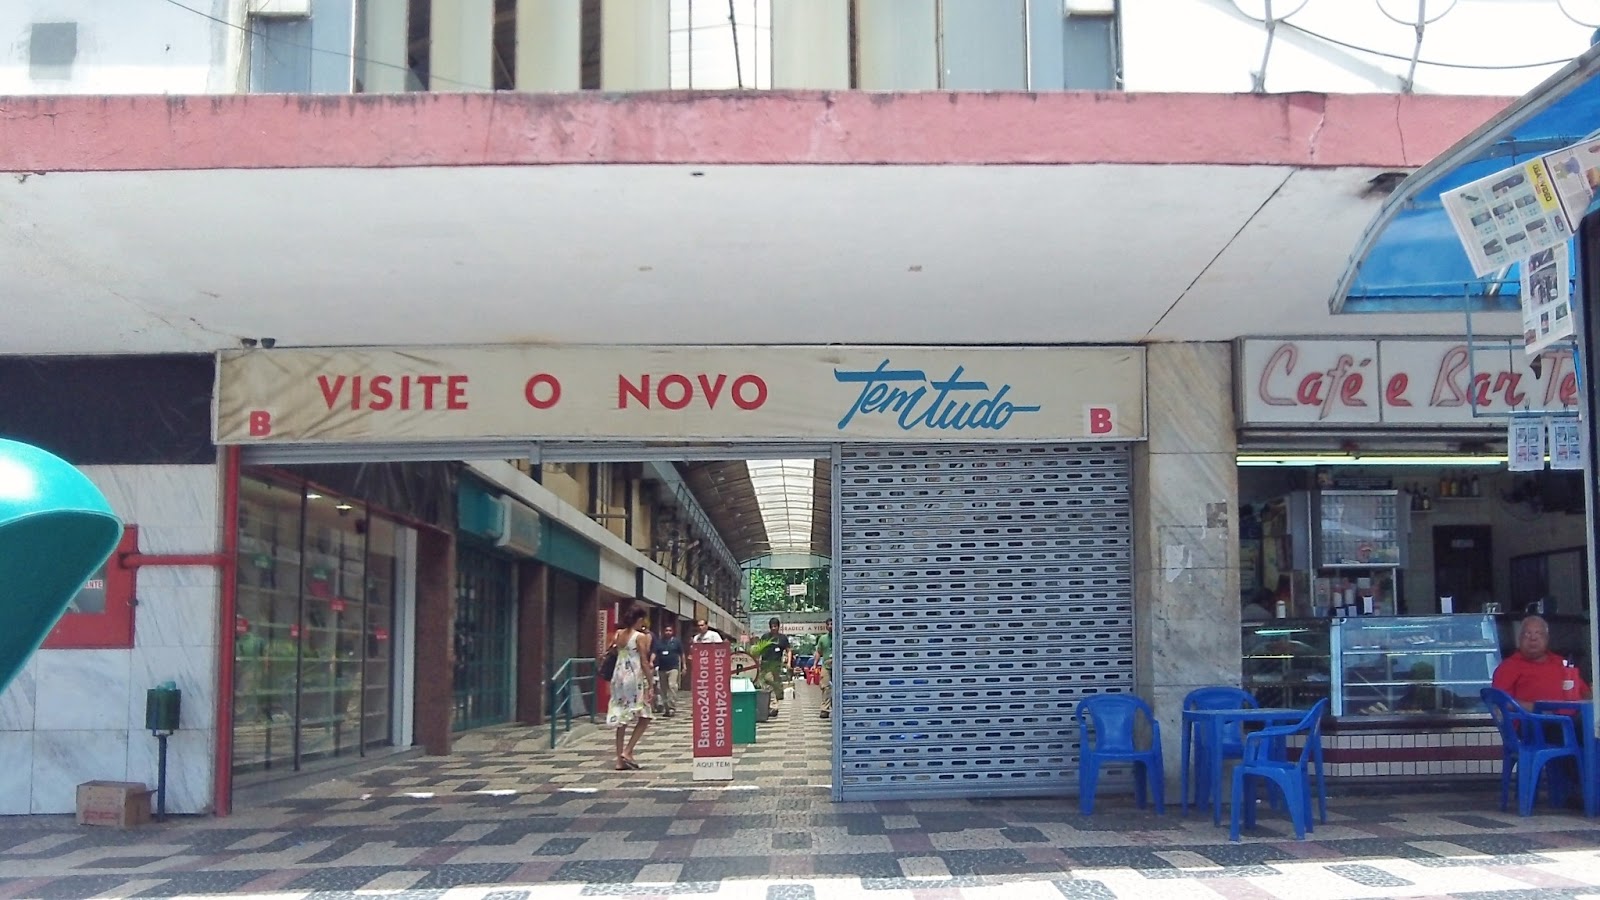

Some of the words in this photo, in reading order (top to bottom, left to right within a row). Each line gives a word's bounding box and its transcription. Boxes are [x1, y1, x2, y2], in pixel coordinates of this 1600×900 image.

[317, 374, 468, 411] VISITE
[524, 373, 561, 410] O
[618, 374, 768, 410] NOVO
[1259, 343, 1371, 420] Café
[1386, 372, 1413, 407] e
[1428, 345, 1526, 408] Bar
[249, 411, 271, 437] B
[1090, 408, 1113, 434] B
[736, 664, 744, 675] P
[697, 649, 710, 748] Banco24Horas
[715, 648, 727, 747] Banco24Horas
